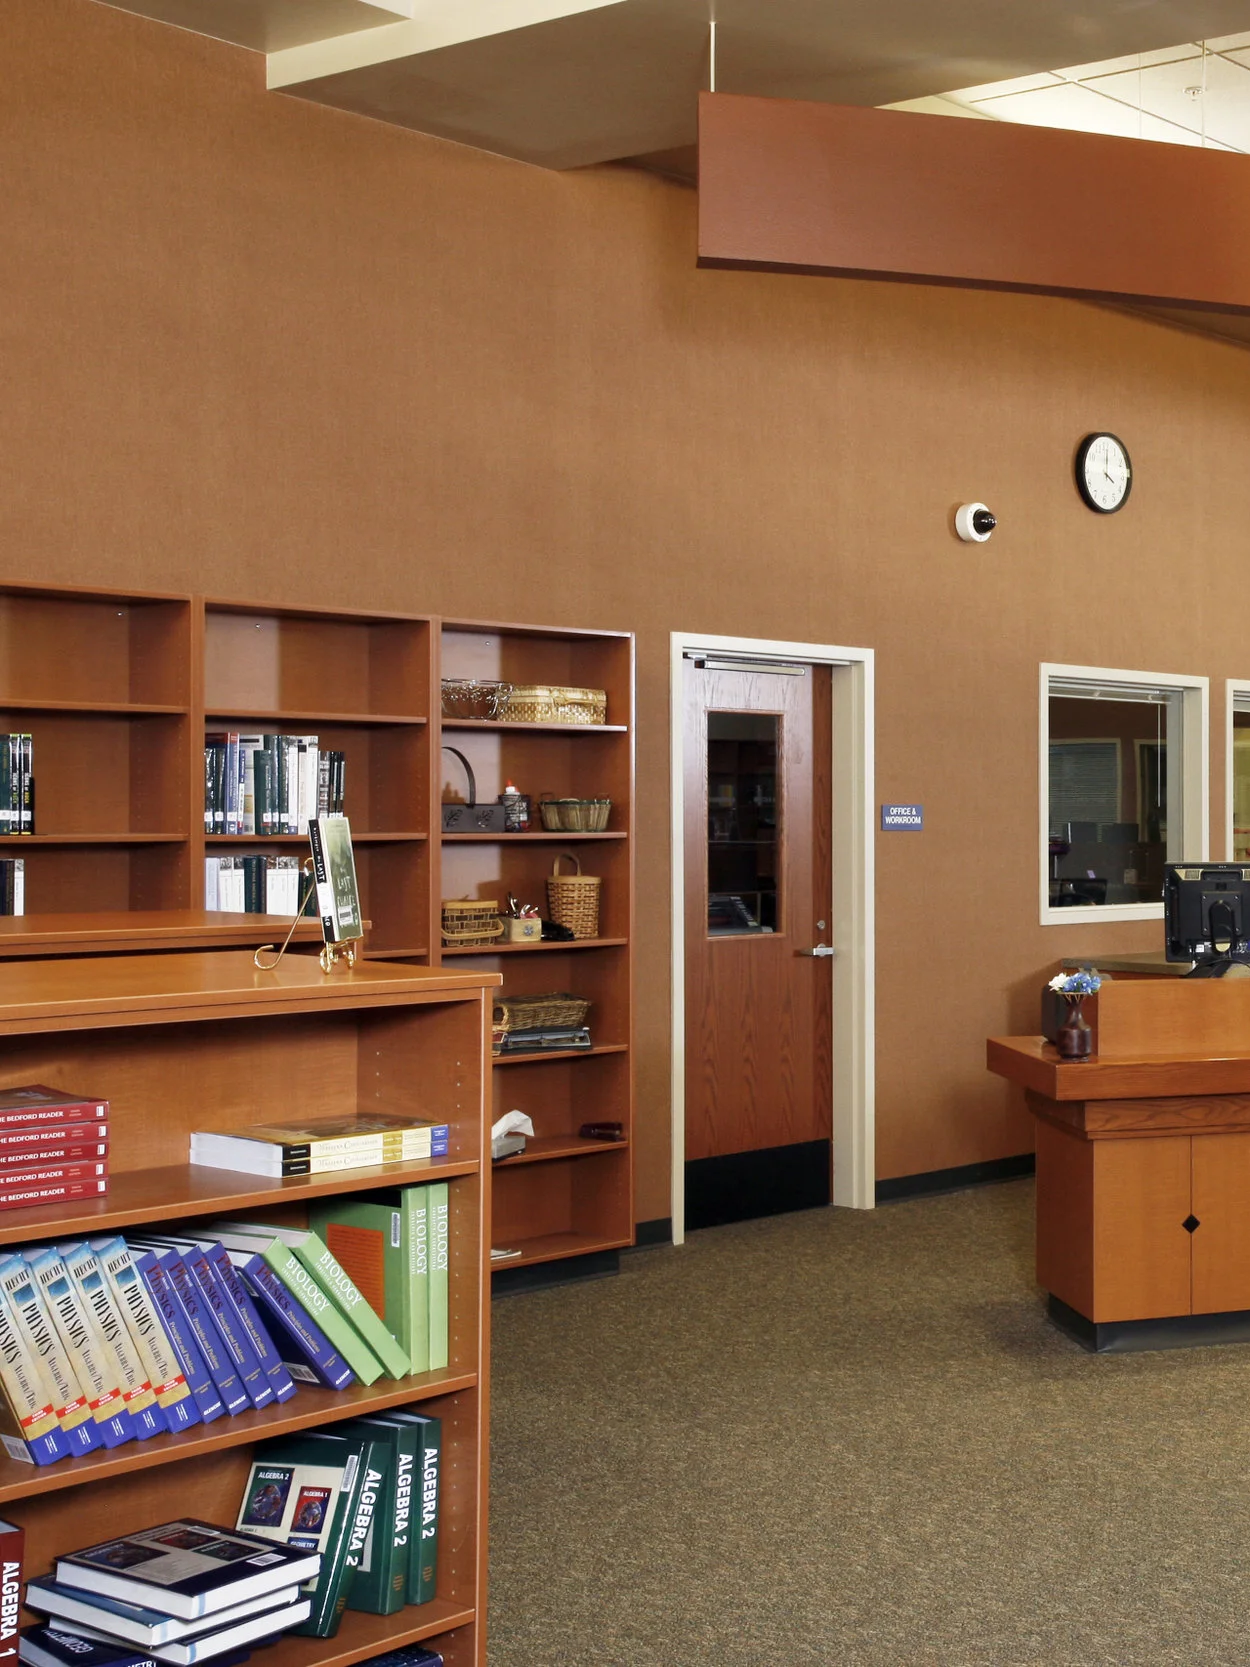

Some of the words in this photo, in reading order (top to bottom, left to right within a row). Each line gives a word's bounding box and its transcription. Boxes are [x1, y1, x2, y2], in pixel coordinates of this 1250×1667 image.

[885, 816, 922, 824] WORKROOM
[890, 807, 910, 815] OFFICE
[7, 1113, 37, 1122] BEDFORD
[9, 1134, 39, 1143] BEDFORD
[41, 1132, 66, 1140] READER
[8, 1153, 38, 1162] BEDFORD
[40, 1150, 64, 1158] READER
[6, 1173, 36, 1182] BEDFORD
[38, 1171, 63, 1179] READER
[8, 1191, 39, 1201] BEDFORD
[40, 1188, 65, 1196] READER
[416, 1208, 427, 1275] BIOLOGY
[438, 1204, 448, 1271] BIOLOGY
[40, 1262, 64, 1284] HECHT
[74, 1256, 98, 1278] HECHT
[108, 1251, 131, 1273] HECHT
[5, 1268, 30, 1292] HECHT
[286, 1256, 330, 1312] BIOLOGY
[319, 1250, 363, 1306] BIOLOGY
[90, 1289, 122, 1341] PHYSICS
[124, 1284, 155, 1336] PHYSICS
[22, 1302, 55, 1356] PHYSICS
[57, 1296, 89, 1348] PHYSICS
[0, 1310, 22, 1364] HYSICS
[258, 1471, 284, 1480] ALGEBRA
[394, 1453, 413, 1533] ALGEBRA
[422, 1448, 438, 1526] ALGEBRA
[349, 1468, 382, 1551] ALGEBRA
[394, 1535, 407, 1547] 2
[422, 1527, 435, 1540] 2
[346, 1555, 358, 1567] 2
[0, 1562, 20, 1640] ALGEBRA
[0, 1647, 16, 1658] 1
